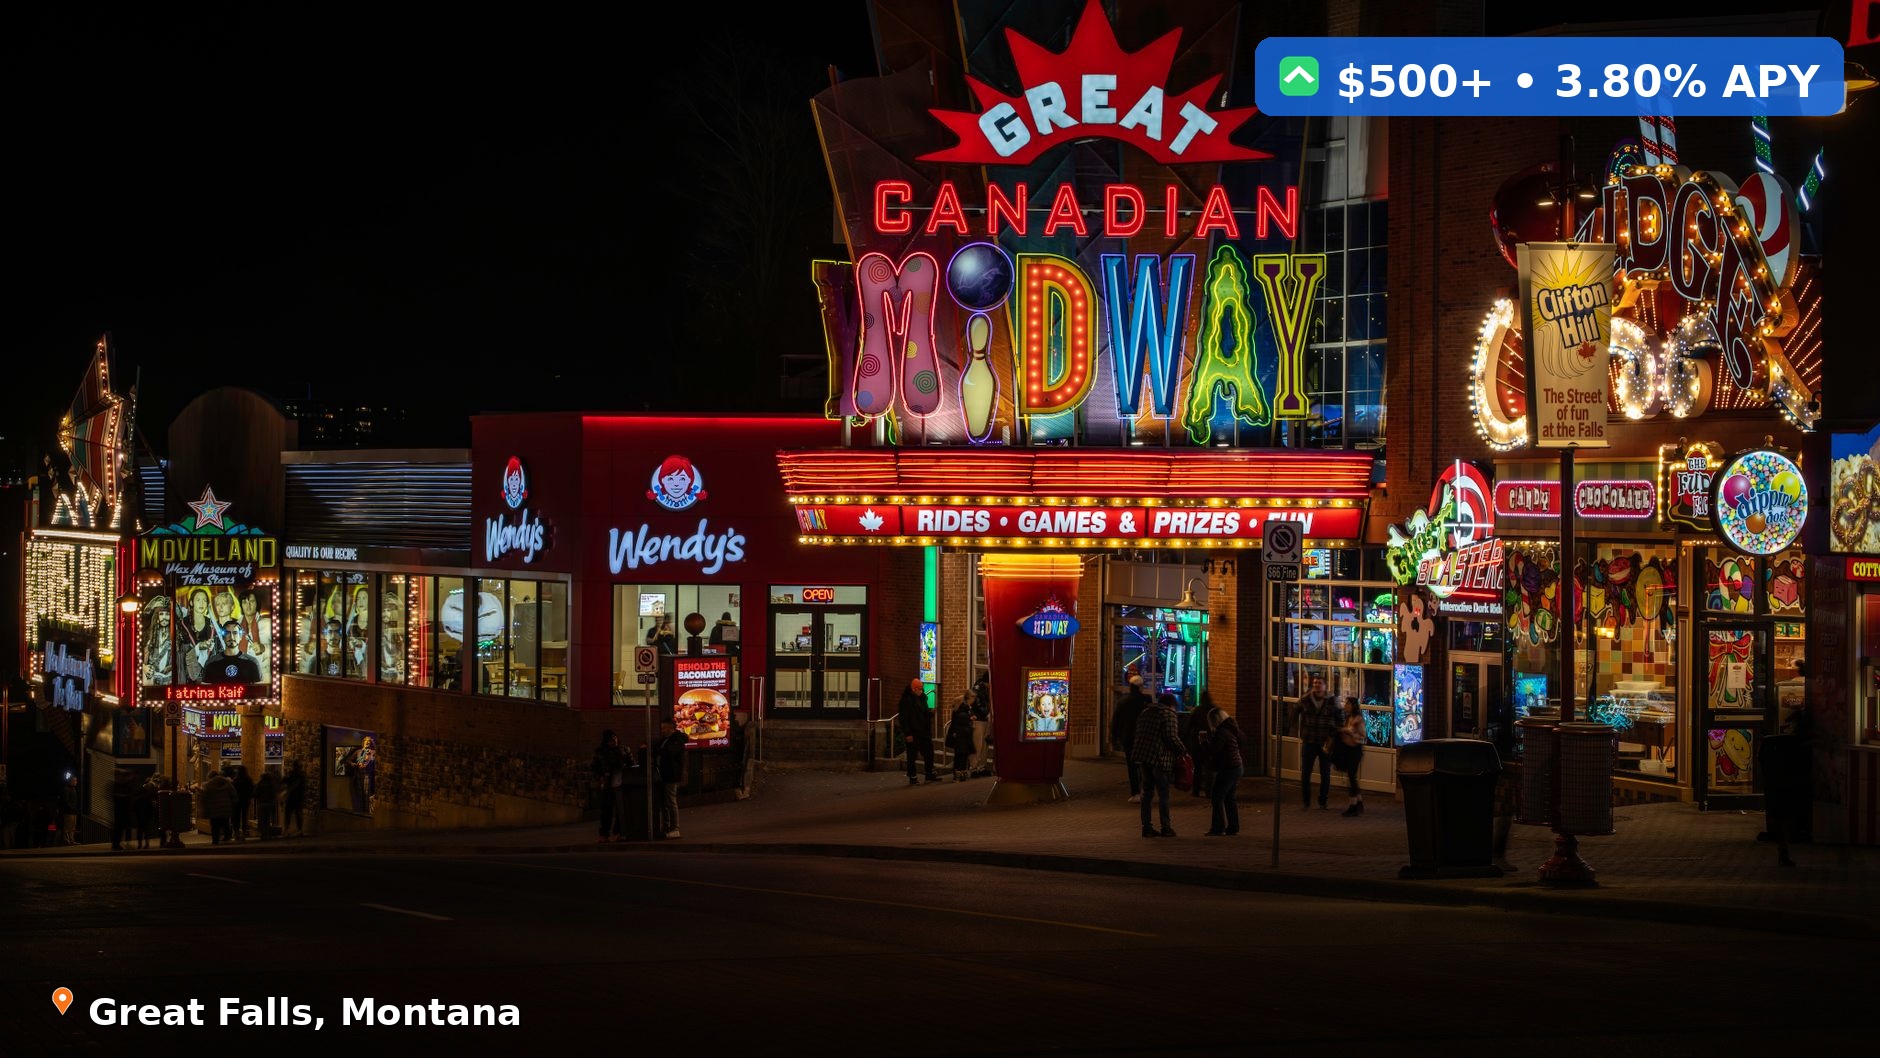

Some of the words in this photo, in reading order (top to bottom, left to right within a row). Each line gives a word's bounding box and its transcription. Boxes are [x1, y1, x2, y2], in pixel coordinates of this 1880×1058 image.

[978, 74, 1218, 158] GREAT
[874, 181, 1299, 240] CANADIAN
[1537, 281, 1608, 321] Clifton
[1558, 312, 1601, 349] Hill
[1543, 387, 1565, 404] The
[1567, 388, 1603, 404] Street
[1556, 404, 1569, 421] of
[1570, 404, 1589, 420] fun
[1542, 422, 1554, 438] at
[1556, 421, 1575, 438] the
[1578, 421, 1604, 438] Falls
[1687, 457, 1707, 471] THE
[1677, 471, 1714, 497] FUD
[1509, 485, 1549, 511] CANDY
[1579, 484, 1650, 510] CHOCOLATE
[917, 509, 991, 533] RIDES
[1018, 510, 1107, 534] GAMES
[1118, 511, 1137, 533] &
[1153, 510, 1240, 534] PRIZES
[1765, 510, 1788, 524] dots
[486, 508, 544, 564] Wendy's
[1386, 501, 1455, 586] GHOST
[142, 537, 277, 569] MOVIELAND
[285, 545, 312, 559] QUALITY
[312, 546, 319, 559] IS
[320, 546, 334, 559] OUR
[335, 547, 358, 560] RECIPE
[608, 518, 747, 575] Wendy's
[166, 562, 189, 575] Wax
[190, 562, 237, 574] Museum
[238, 562, 253, 578] of
[1281, 566, 1297, 579] Fine
[1852, 561, 1880, 578] COTT
[181, 574, 202, 585] The
[203, 573, 236, 586] Stars
[803, 588, 833, 600] OPEN
[1439, 600, 1473, 613] Interactive
[1473, 602, 1490, 614] Dark
[677, 662, 711, 671] BEHOLD
[711, 661, 727, 670] THE
[677, 670, 727, 680] BACONATOR
[218, 686, 245, 698] Kaif
